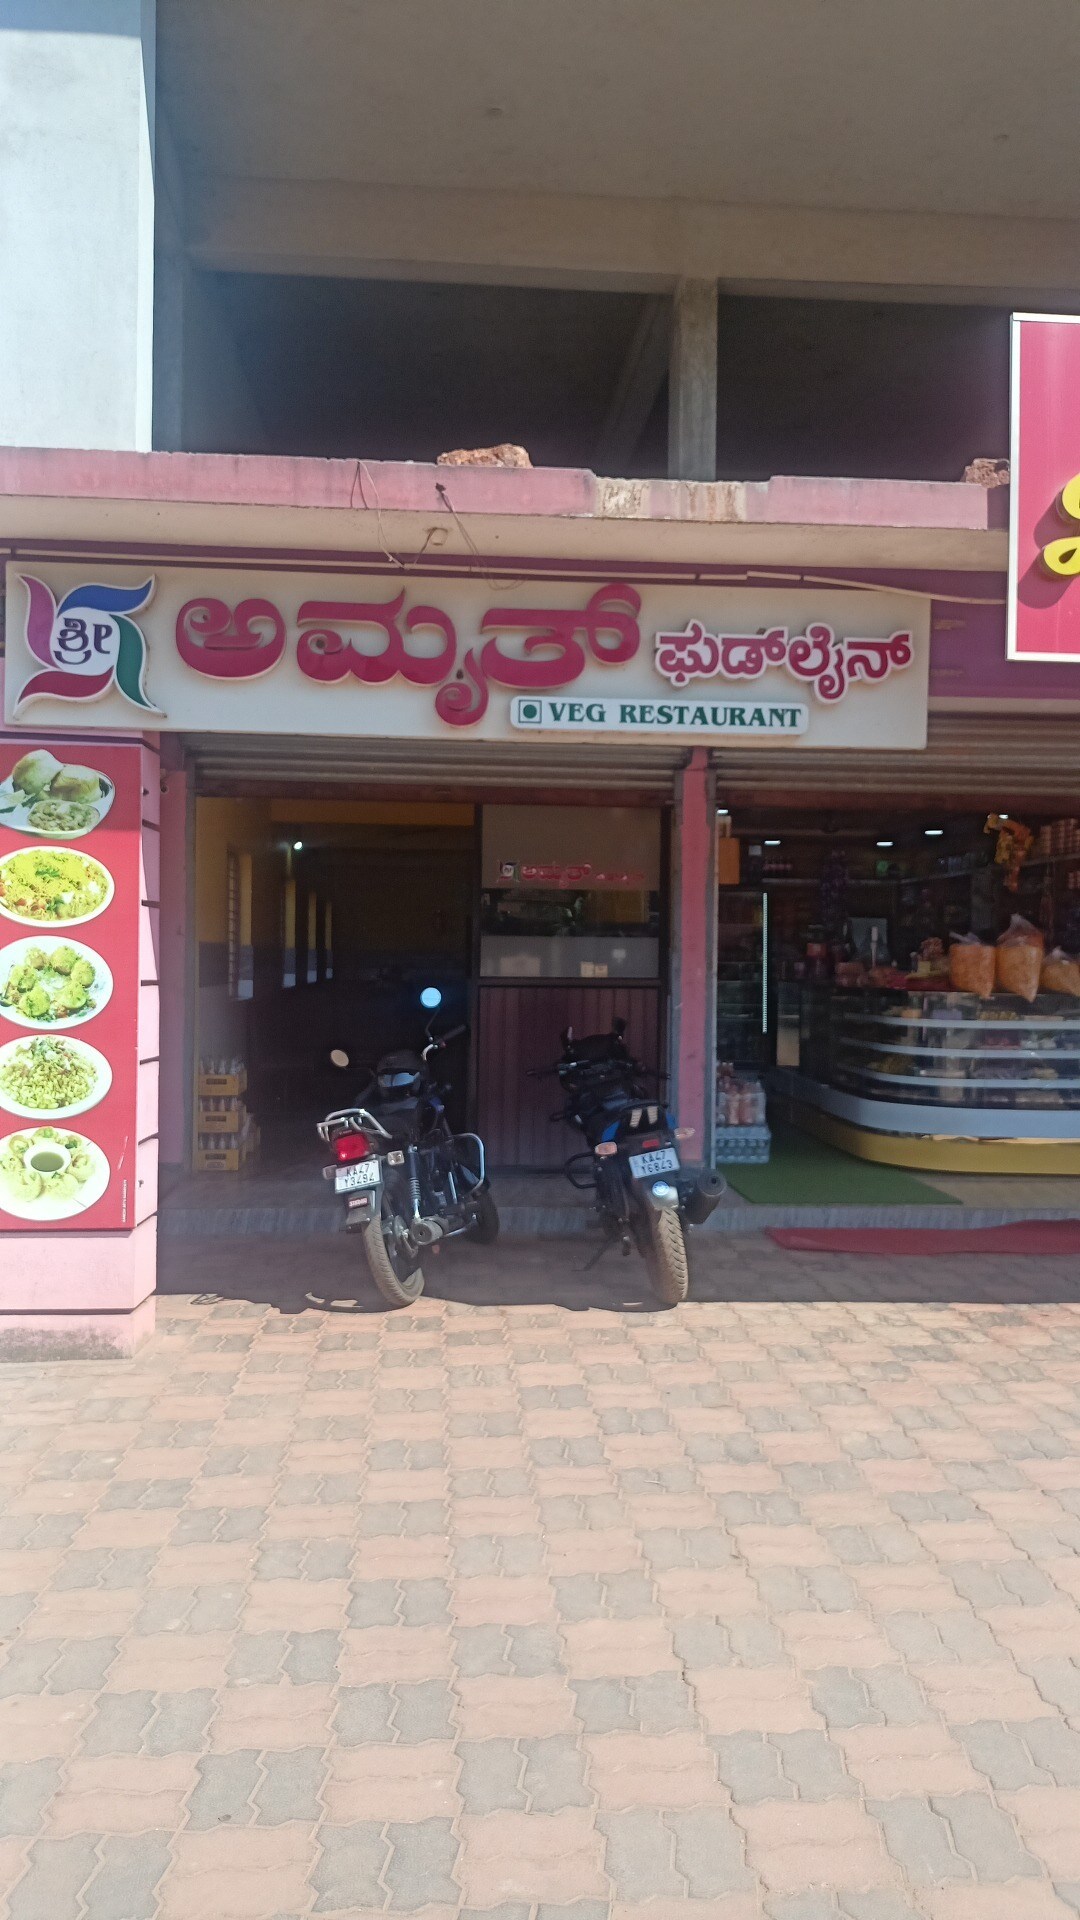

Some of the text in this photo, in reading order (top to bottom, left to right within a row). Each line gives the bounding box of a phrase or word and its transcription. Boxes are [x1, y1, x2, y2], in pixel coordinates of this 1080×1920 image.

[55, 617, 113, 665] ಶ್ರೀ
[175, 583, 643, 727] ಅಮೃತ್
[549, 702, 802, 728] VEG RESTAURANT
